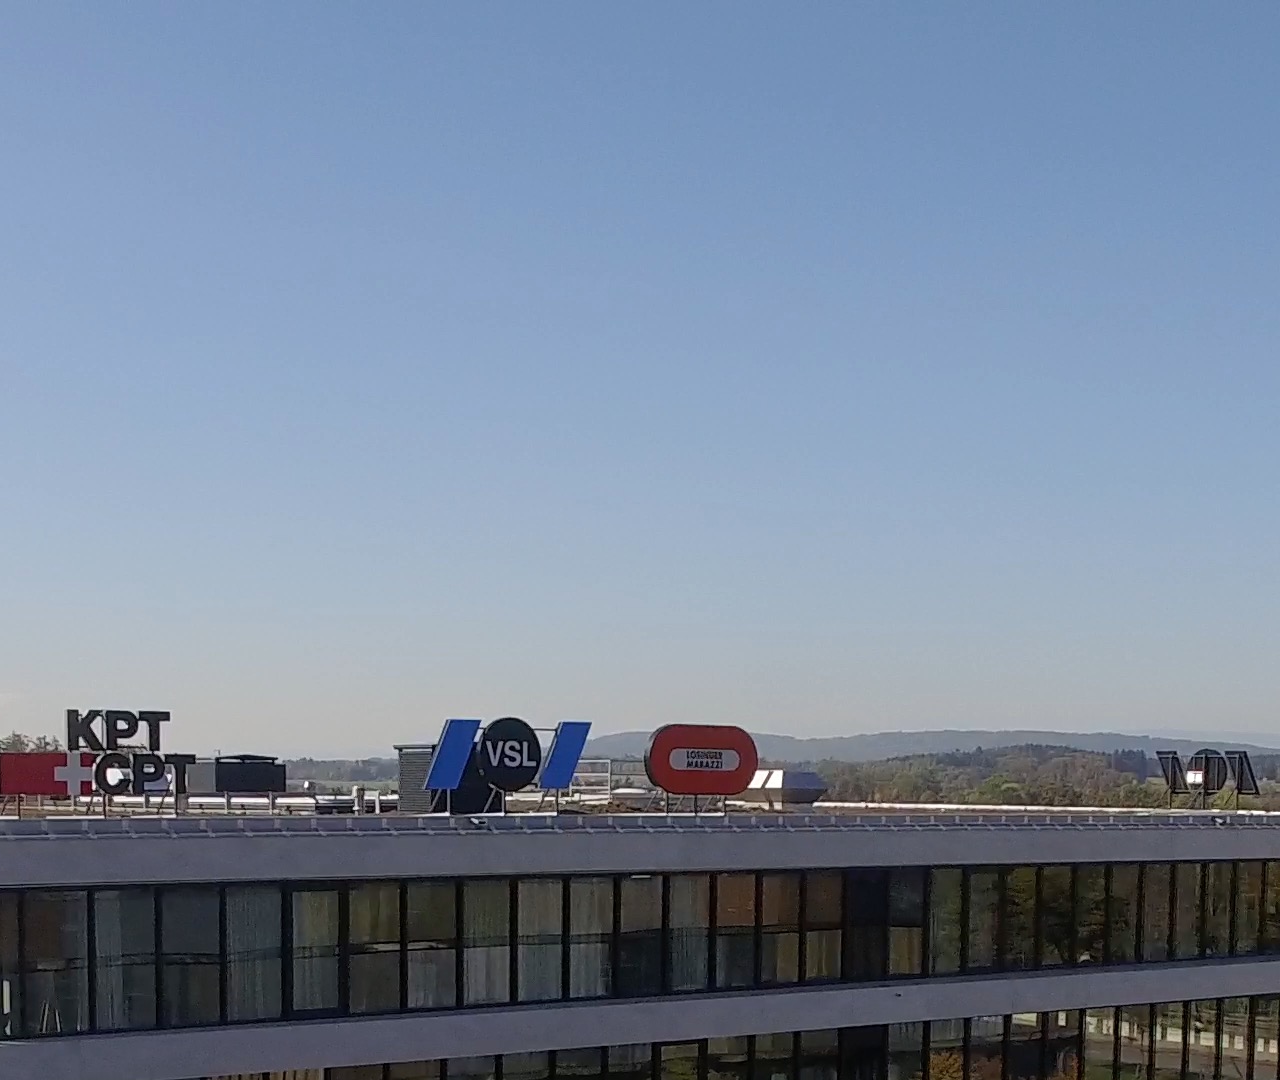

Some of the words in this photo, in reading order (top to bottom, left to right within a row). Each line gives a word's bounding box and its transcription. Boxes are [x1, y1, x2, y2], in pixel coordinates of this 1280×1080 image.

[67, 709, 171, 752] KPT
[95, 752, 196, 795] CPT
[486, 740, 537, 767] VSL
